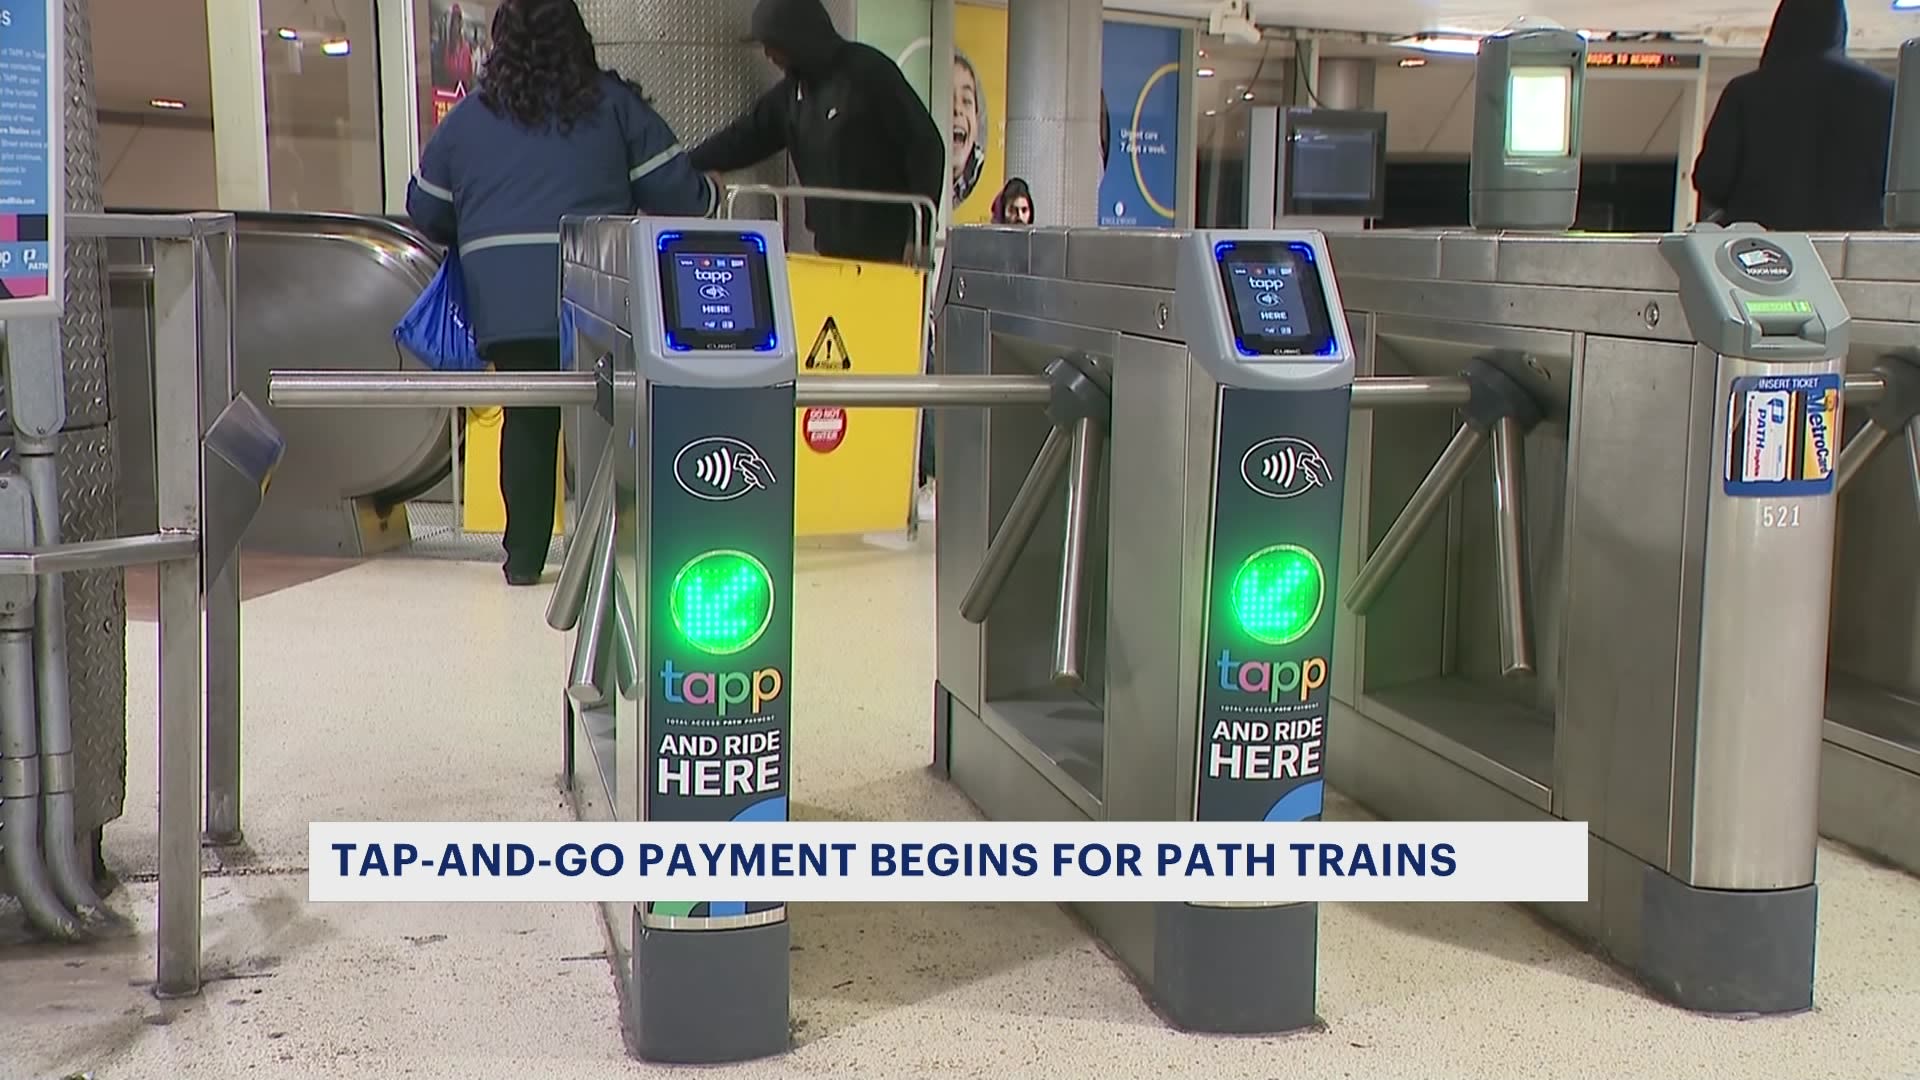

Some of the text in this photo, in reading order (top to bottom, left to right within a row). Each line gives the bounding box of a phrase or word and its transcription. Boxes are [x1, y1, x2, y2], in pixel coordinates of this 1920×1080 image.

[695, 269, 732, 284] tapp
[1250, 277, 1284, 291] tapp
[702, 305, 731, 314] HERE
[1758, 377, 1819, 389] INSERT TICKET
[1755, 408, 1768, 449] PATH
[1762, 506, 1800, 527] 521
[660, 659, 783, 716] tapp
[1217, 650, 1328, 704] tapp
[1212, 717, 1322, 741] AND RIDE
[659, 730, 780, 756] AND RIDE
[1209, 740, 1321, 779] HERE
[658, 754, 780, 796] HERE
